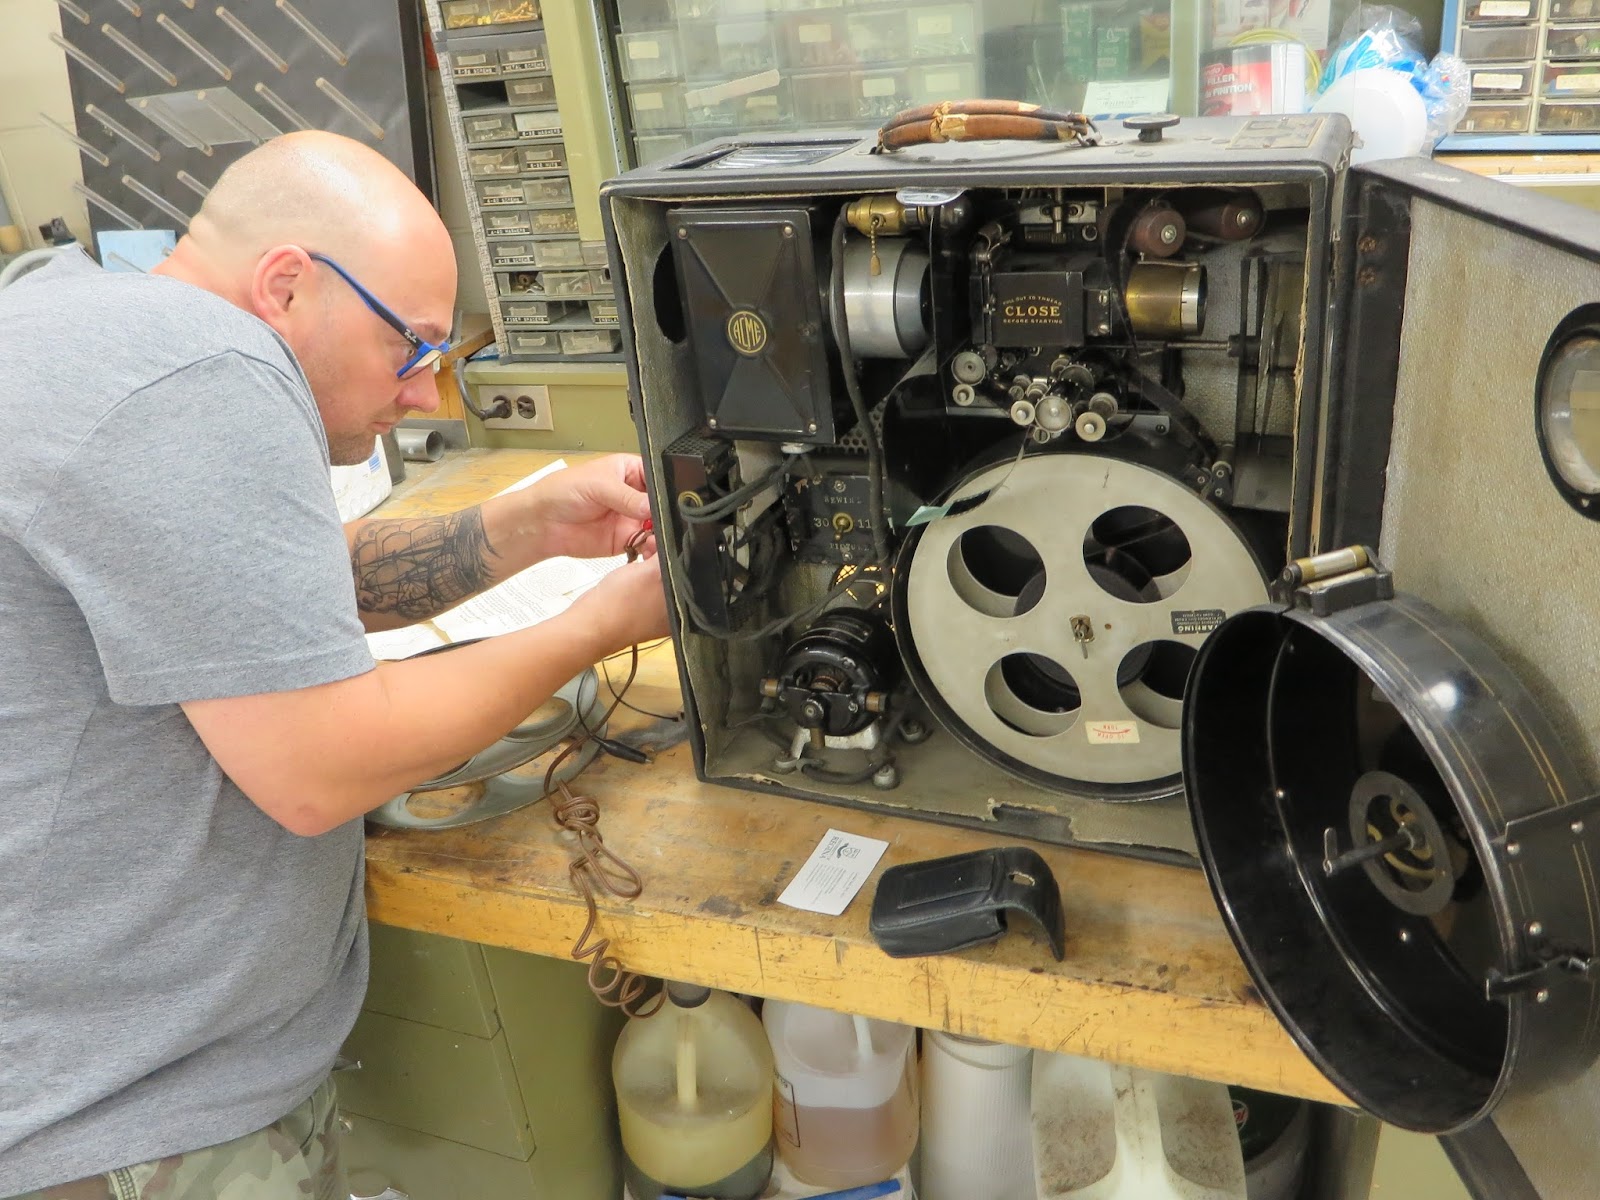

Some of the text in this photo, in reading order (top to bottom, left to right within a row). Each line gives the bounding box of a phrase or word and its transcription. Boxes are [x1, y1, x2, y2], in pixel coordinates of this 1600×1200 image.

[1038, 295, 1062, 306] THREAD
[1005, 305, 1061, 317] CLOSE
[733, 317, 761, 348] ACME
